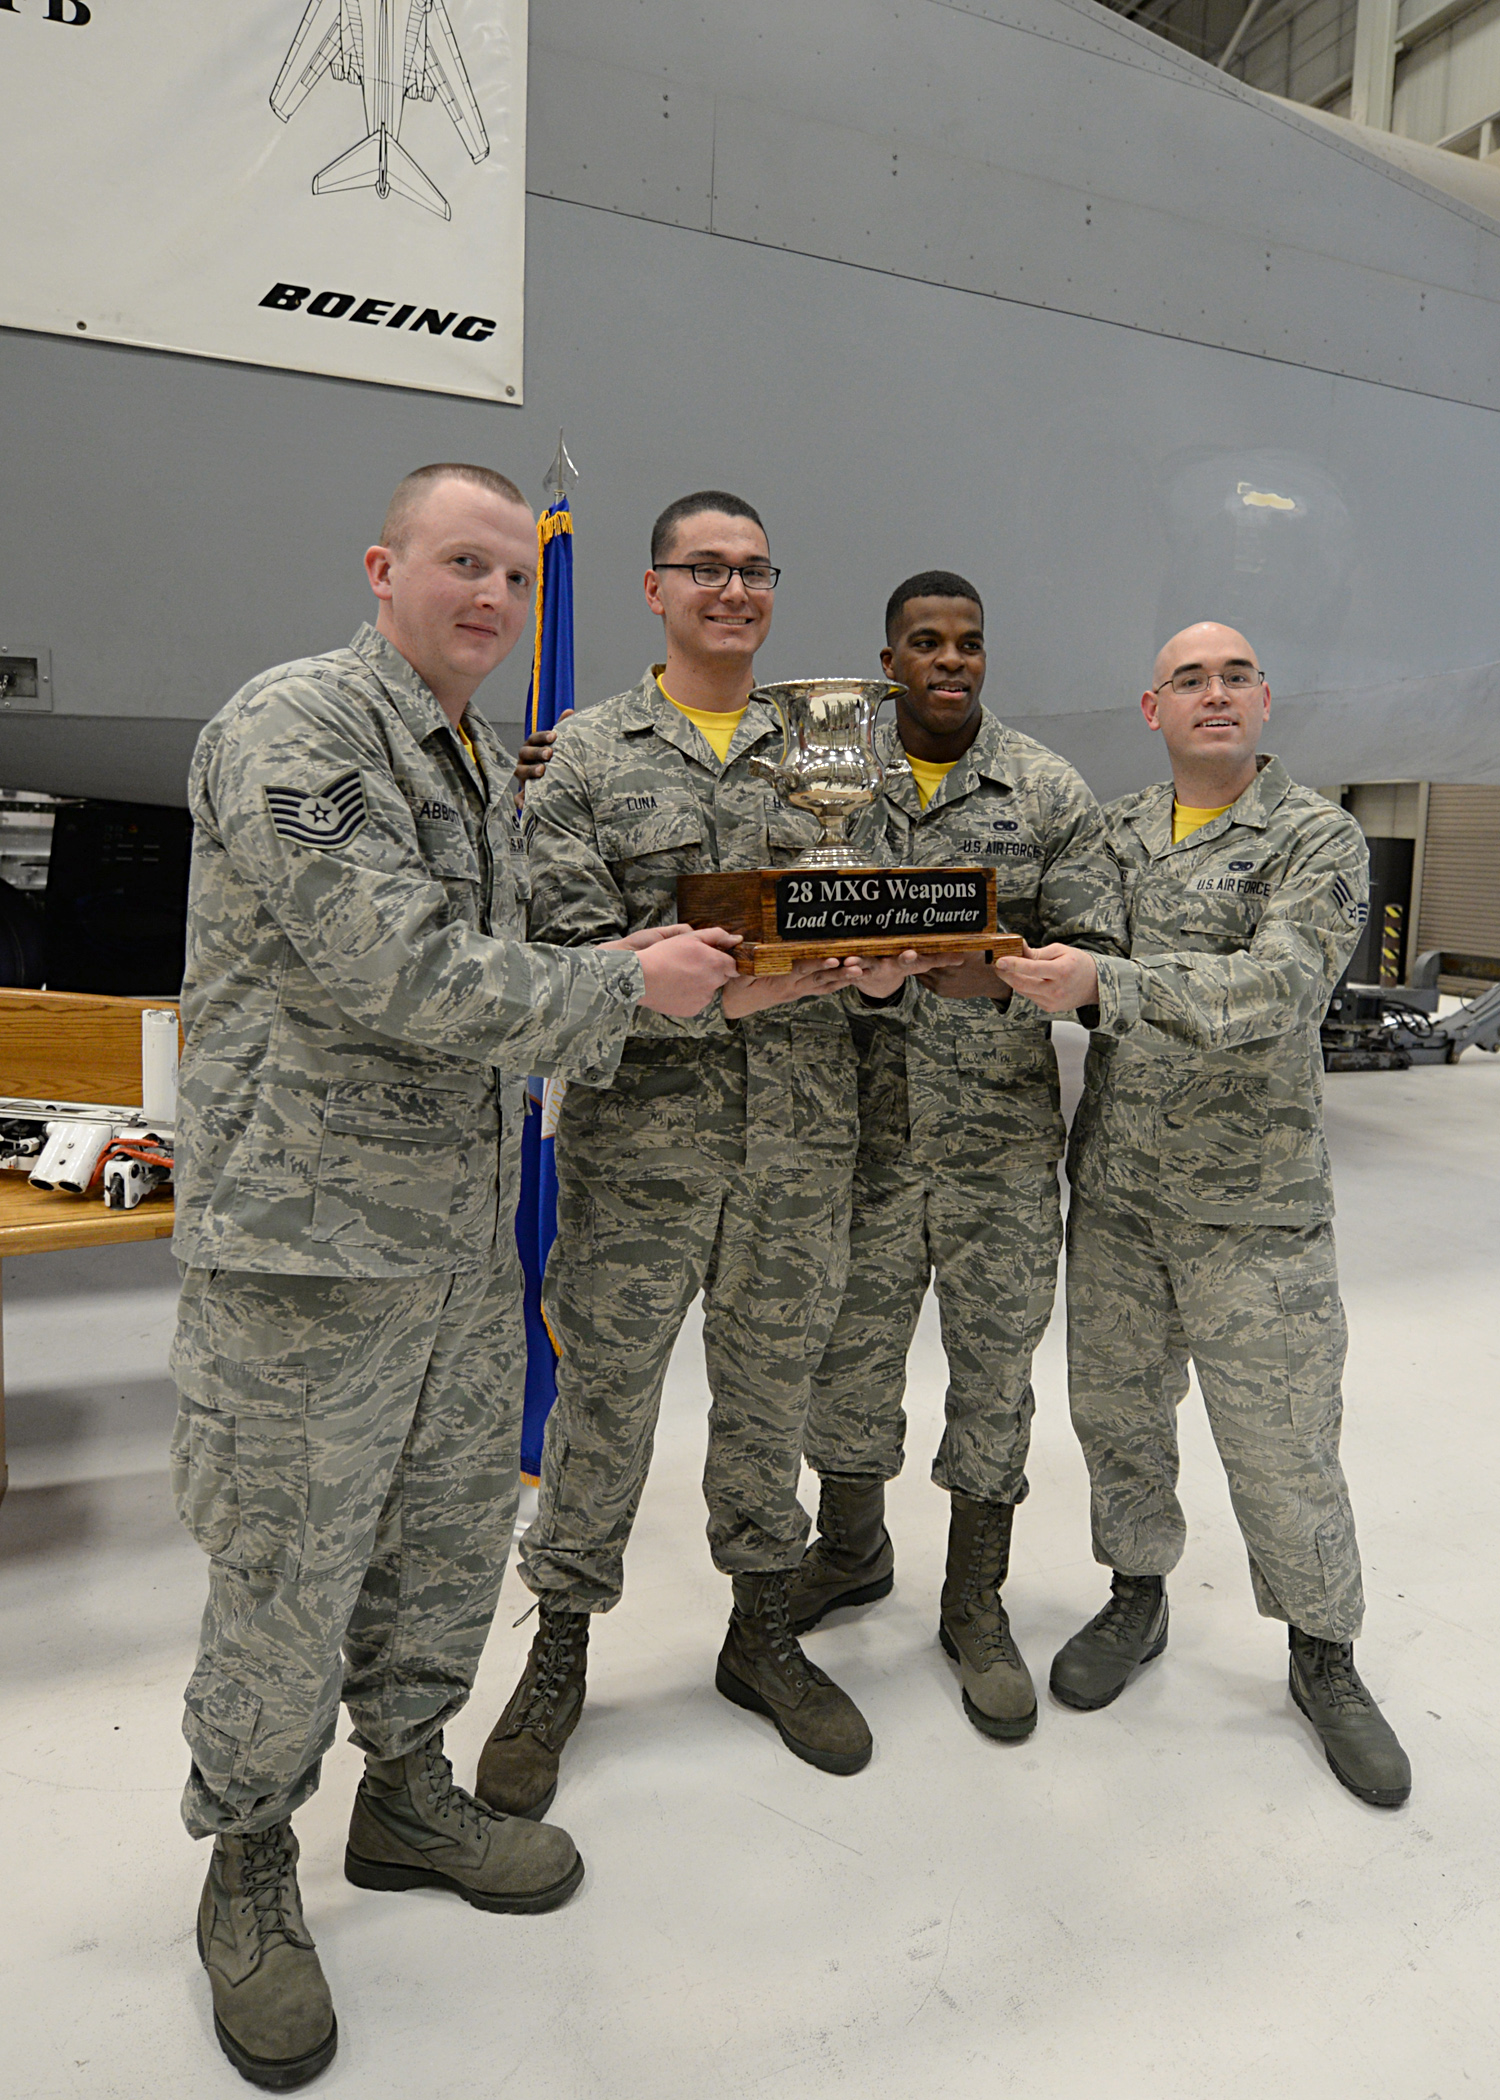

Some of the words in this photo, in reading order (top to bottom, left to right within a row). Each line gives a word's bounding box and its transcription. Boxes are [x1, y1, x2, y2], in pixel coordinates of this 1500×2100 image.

[258, 282, 497, 342] BOEING
[626, 795, 658, 812] LUNA
[1006, 842, 1041, 858] FORCE
[787, 881, 814, 903] 28
[820, 879, 881, 902] MXG
[886, 879, 977, 904] Weapons
[1196, 879, 1214, 891] U.S.
[1216, 878, 1235, 892] AIR
[1236, 880, 1271, 898] FORCE
[785, 911, 828, 929] Load
[831, 910, 873, 927] Crew
[875, 908, 895, 929] of
[895, 908, 919, 924] the
[922, 907, 980, 927] Quarter
